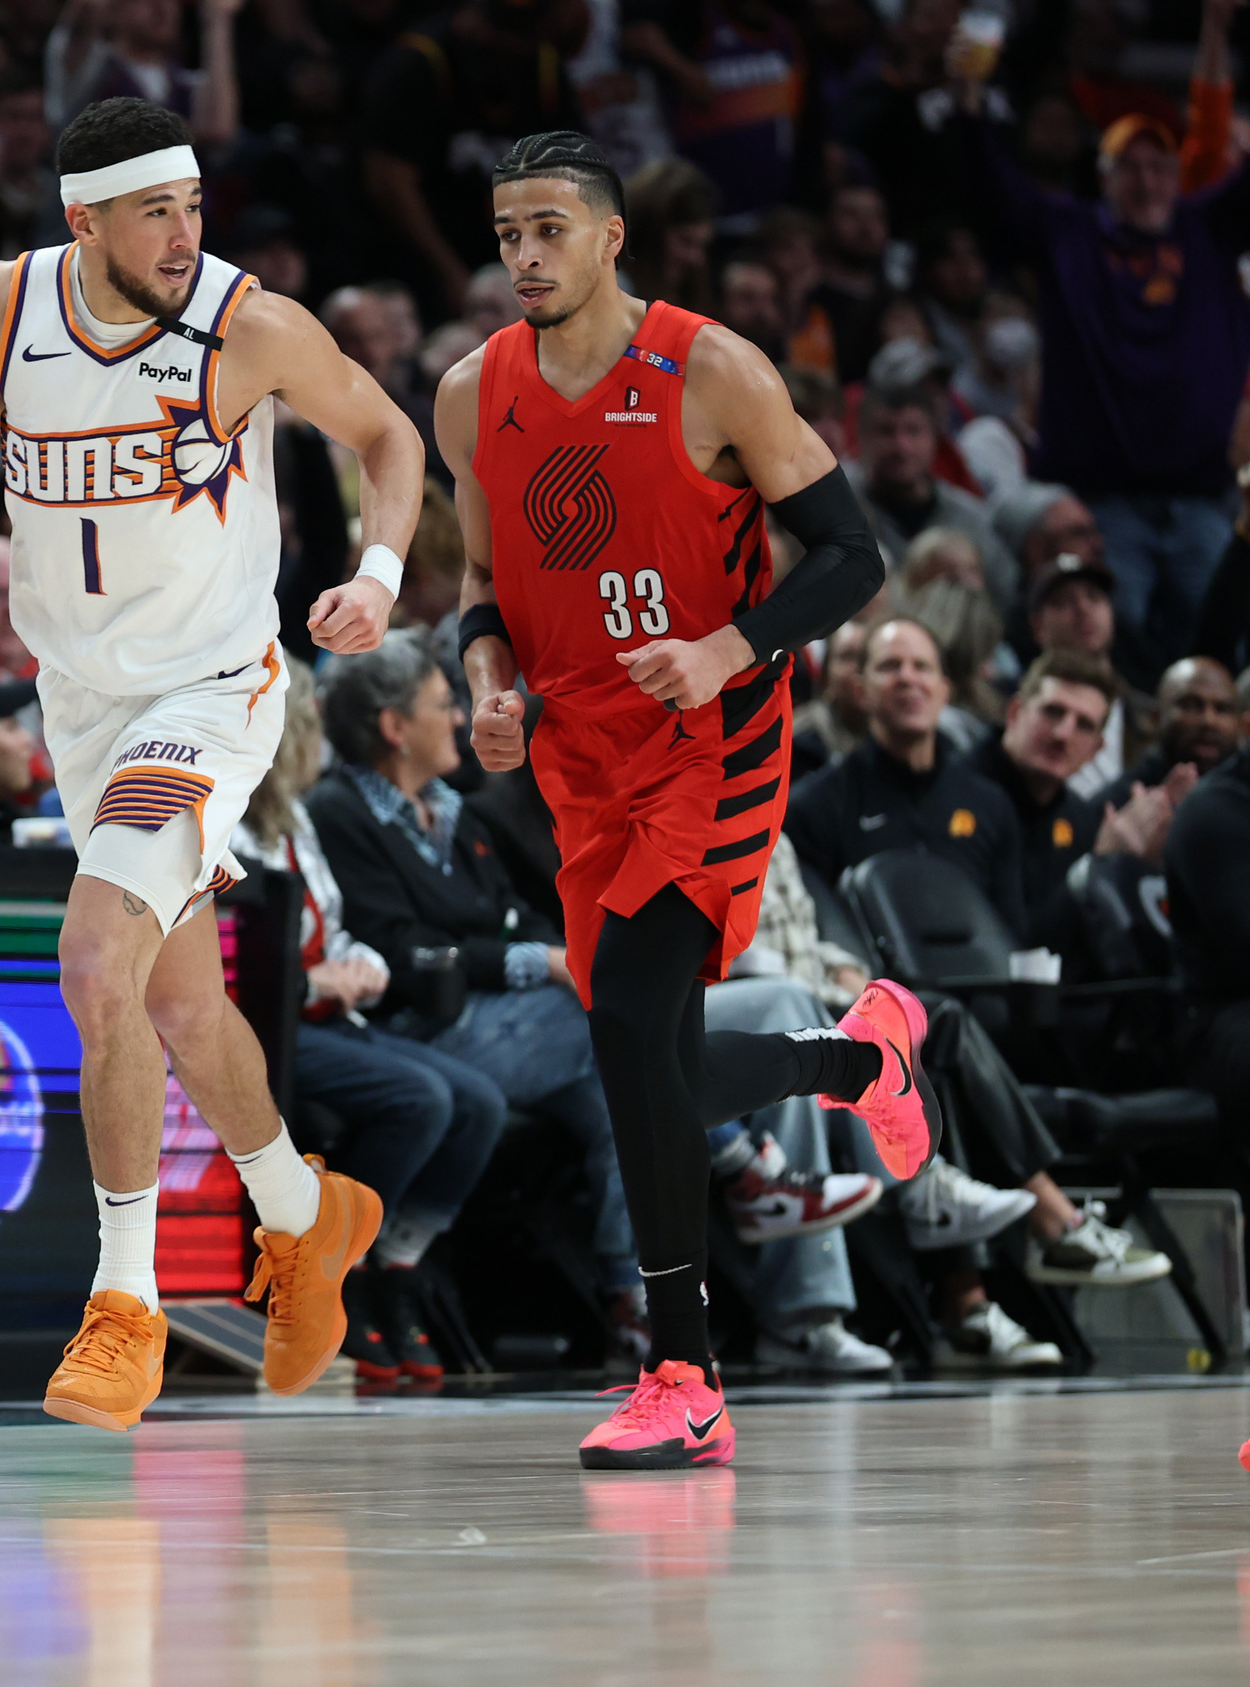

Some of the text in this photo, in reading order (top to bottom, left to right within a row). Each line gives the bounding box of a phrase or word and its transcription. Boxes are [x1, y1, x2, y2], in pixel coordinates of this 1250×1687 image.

[183, 327, 196, 340] AL
[646, 352, 663, 367] 32
[138, 362, 193, 384] PayPal
[604, 412, 658, 423] BRIGHTSIDE
[79, 517, 108, 596] 1
[598, 567, 671, 641] 33
